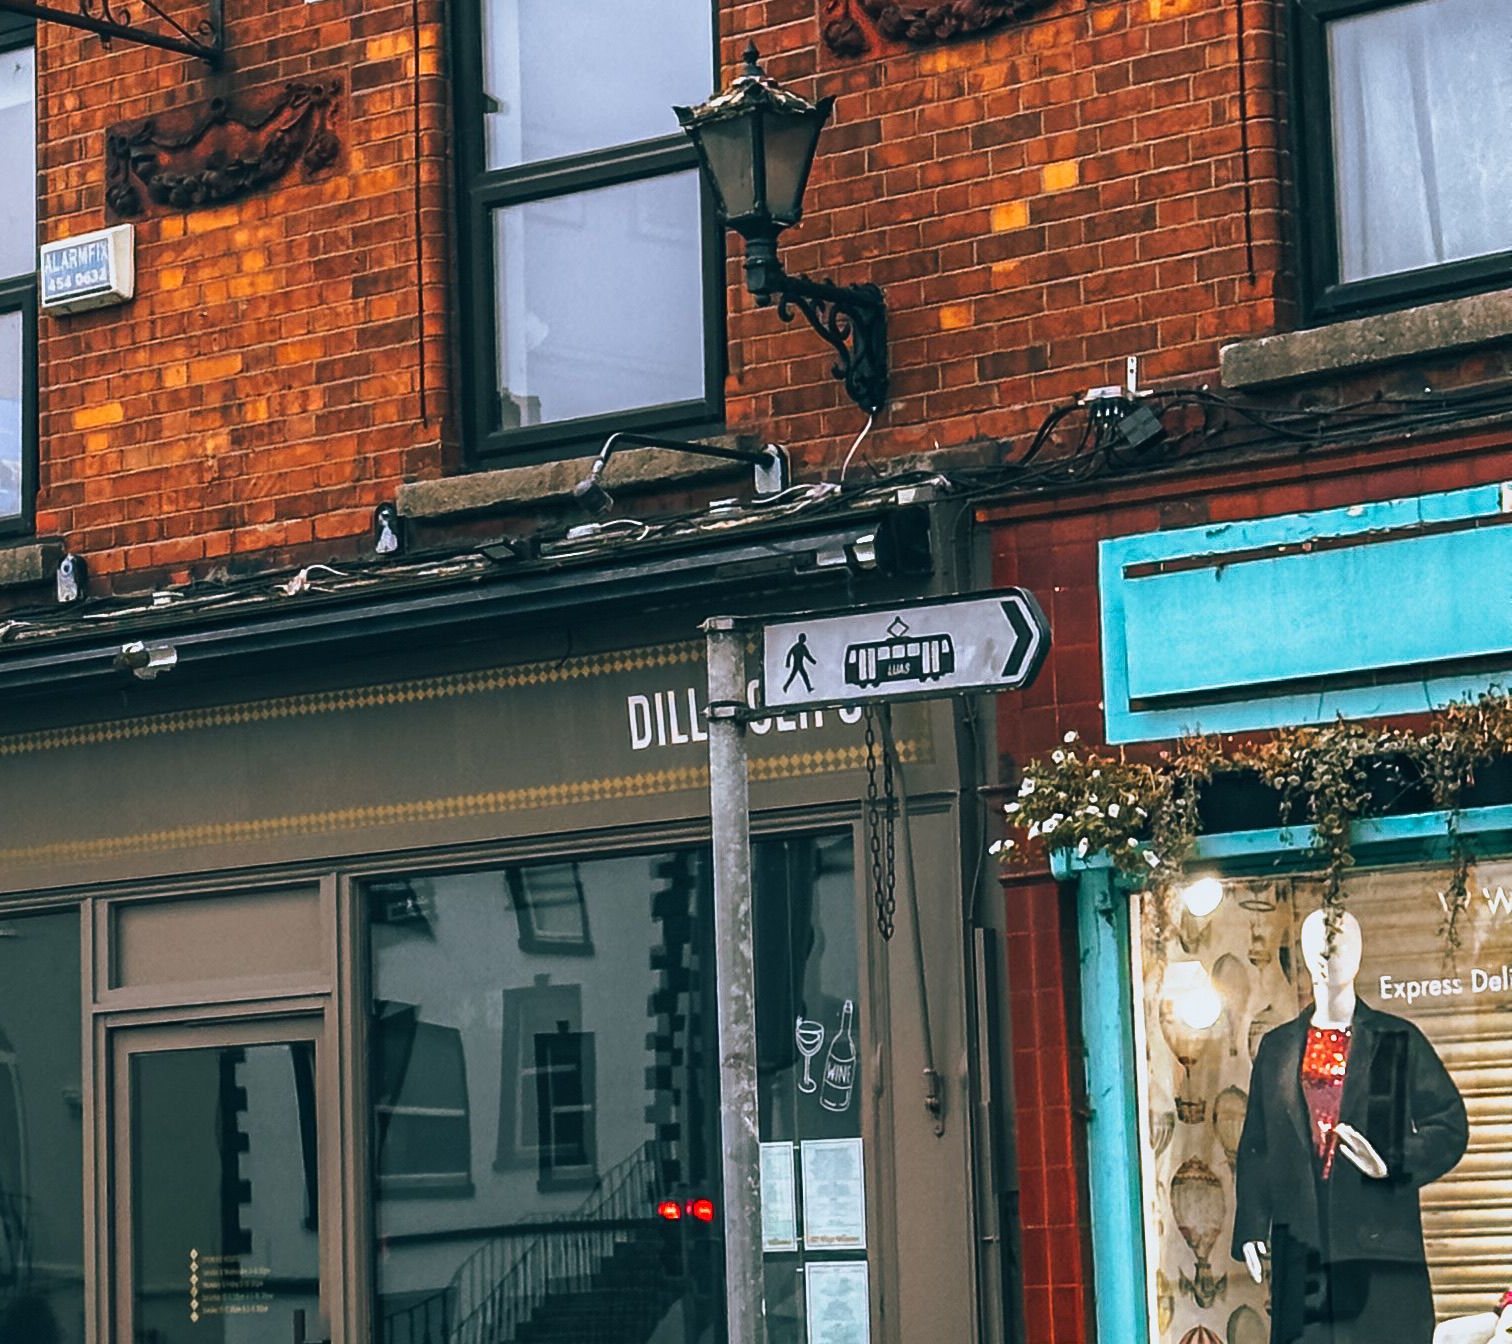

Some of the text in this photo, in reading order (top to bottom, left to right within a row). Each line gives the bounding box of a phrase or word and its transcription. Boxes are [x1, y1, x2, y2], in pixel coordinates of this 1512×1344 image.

[44, 240, 108, 274] ALARMFIX
[48, 275, 72, 292] 454
[887, 661, 911, 676] LUAS
[1380, 975, 1464, 1005] Express
[827, 1061, 852, 1084] WINE
